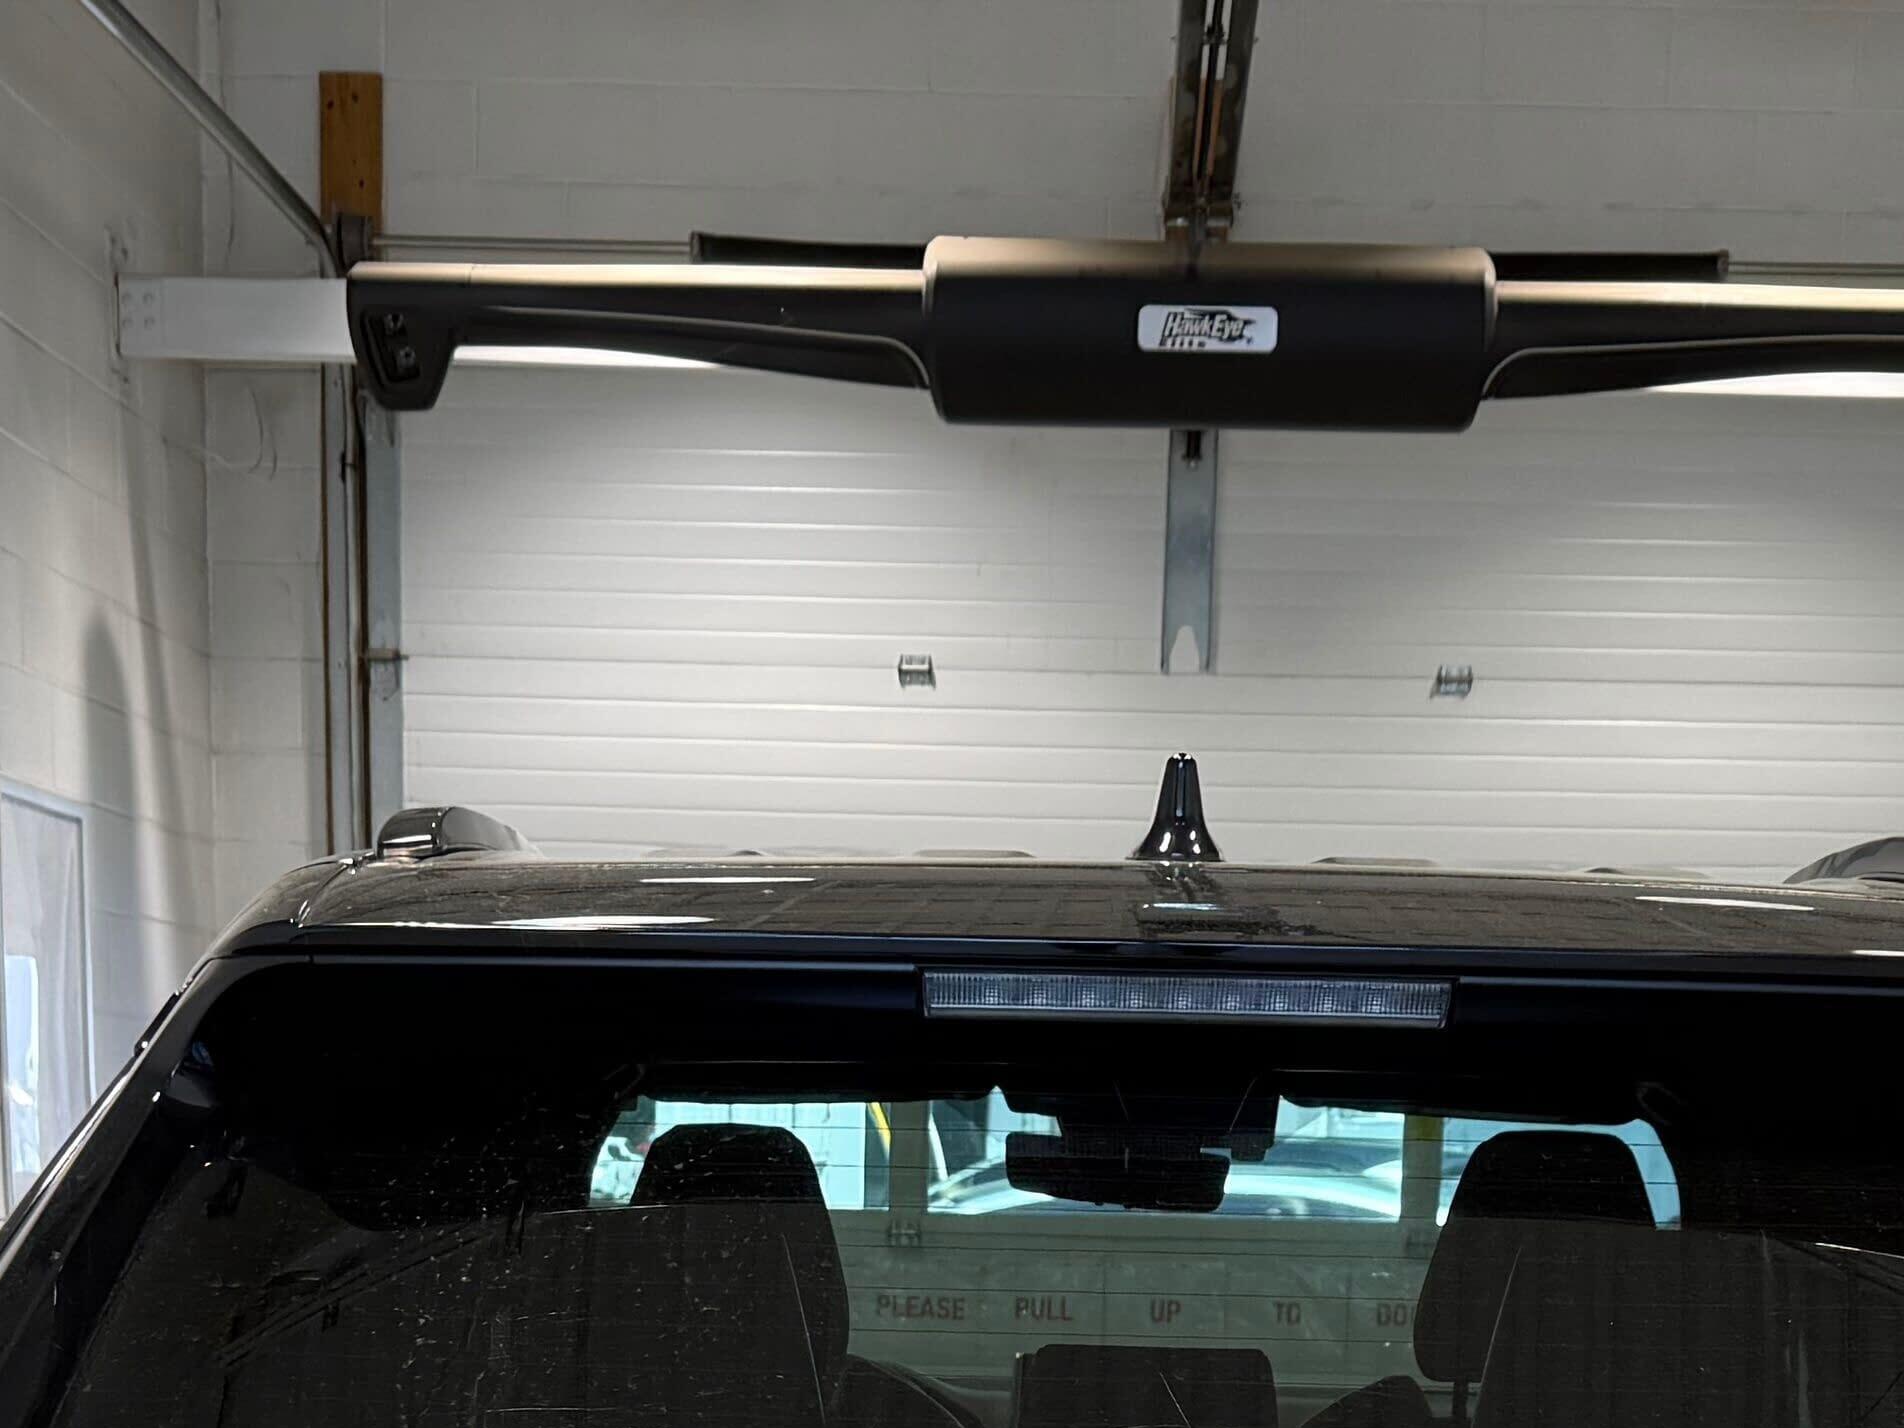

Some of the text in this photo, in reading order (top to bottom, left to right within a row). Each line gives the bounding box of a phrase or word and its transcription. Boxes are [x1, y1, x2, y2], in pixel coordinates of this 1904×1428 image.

[1162, 311, 1245, 339] HawkEye
[876, 1294, 1414, 1328] PLEASE PULL UP TO DO
